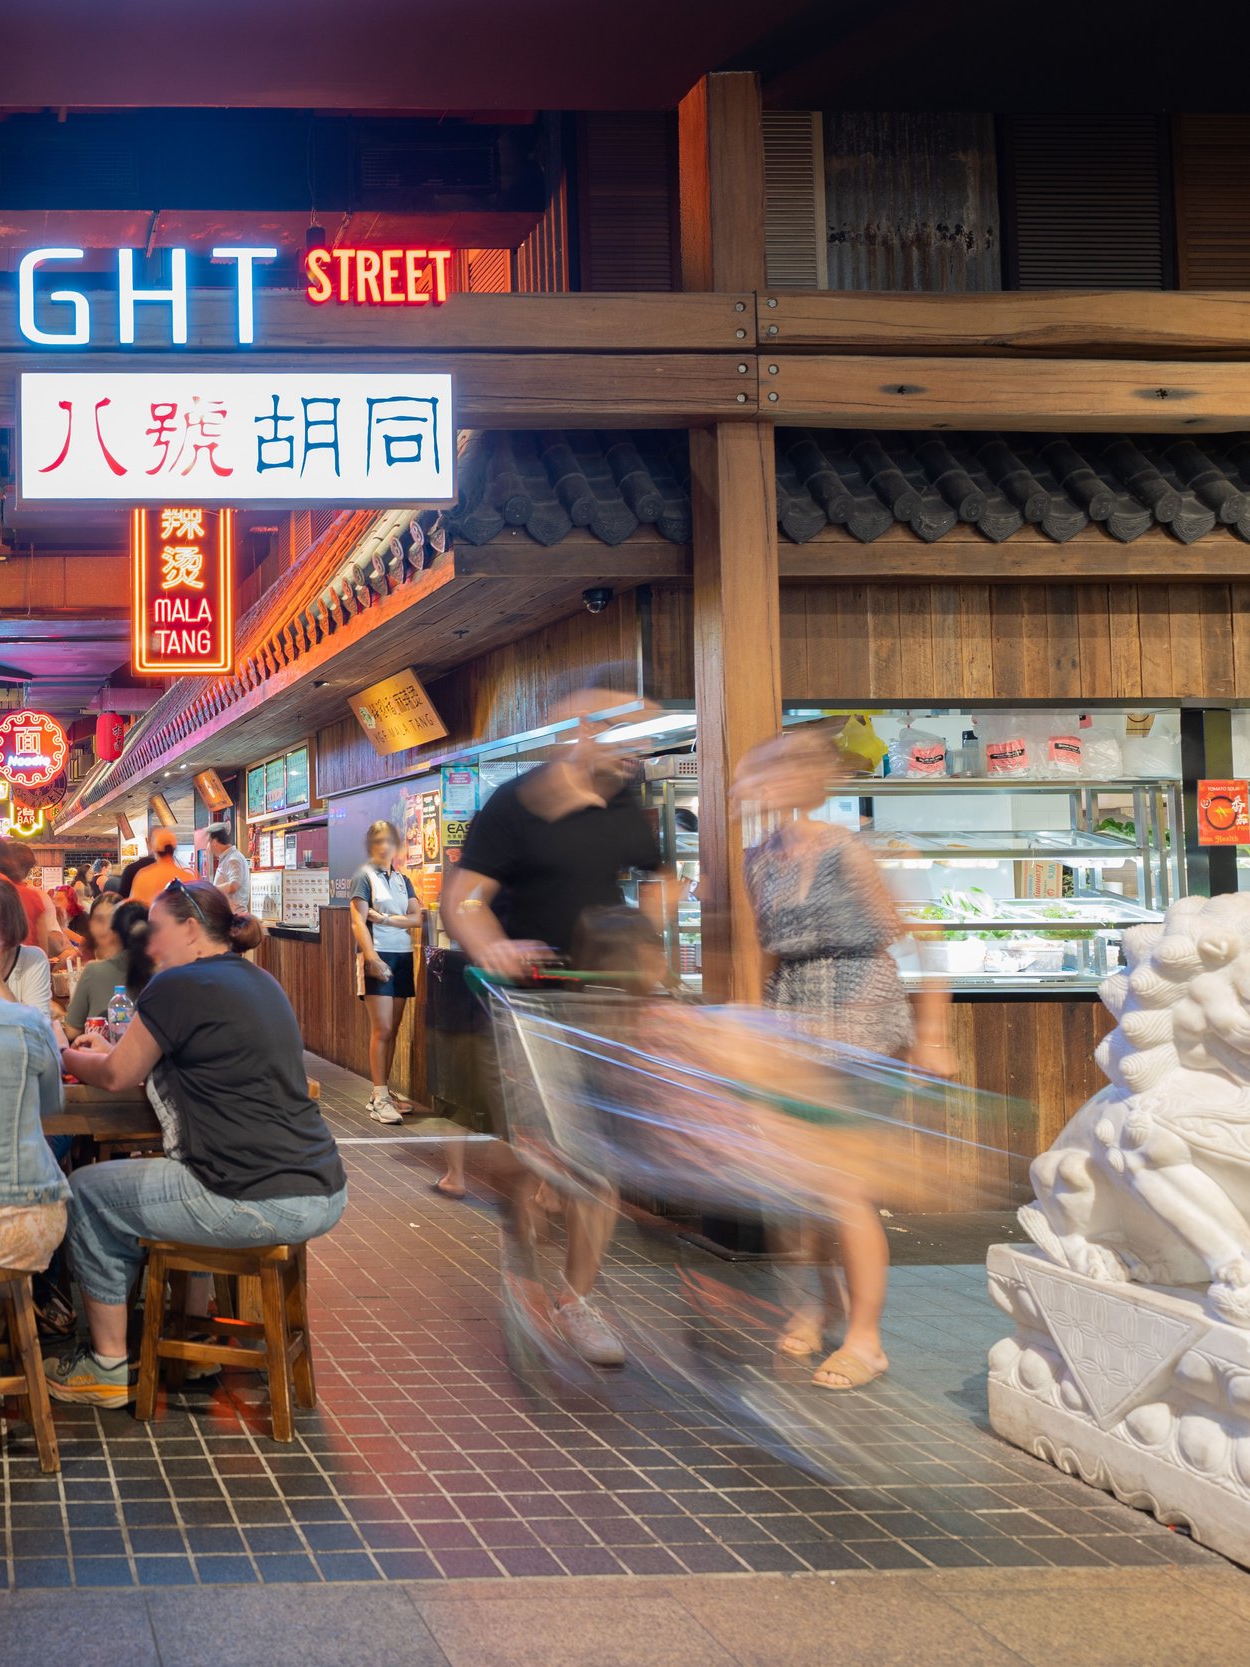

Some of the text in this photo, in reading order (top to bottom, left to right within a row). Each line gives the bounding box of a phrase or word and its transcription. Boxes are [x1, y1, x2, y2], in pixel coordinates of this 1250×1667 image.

[306, 247, 451, 303] STREET
[37, 394, 441, 479] 八號胡同
[154, 598, 213, 623] MALA
[154, 629, 212, 655] TANG
[408, 712, 435, 732] TANG
[17, 816, 36, 825] BAR
